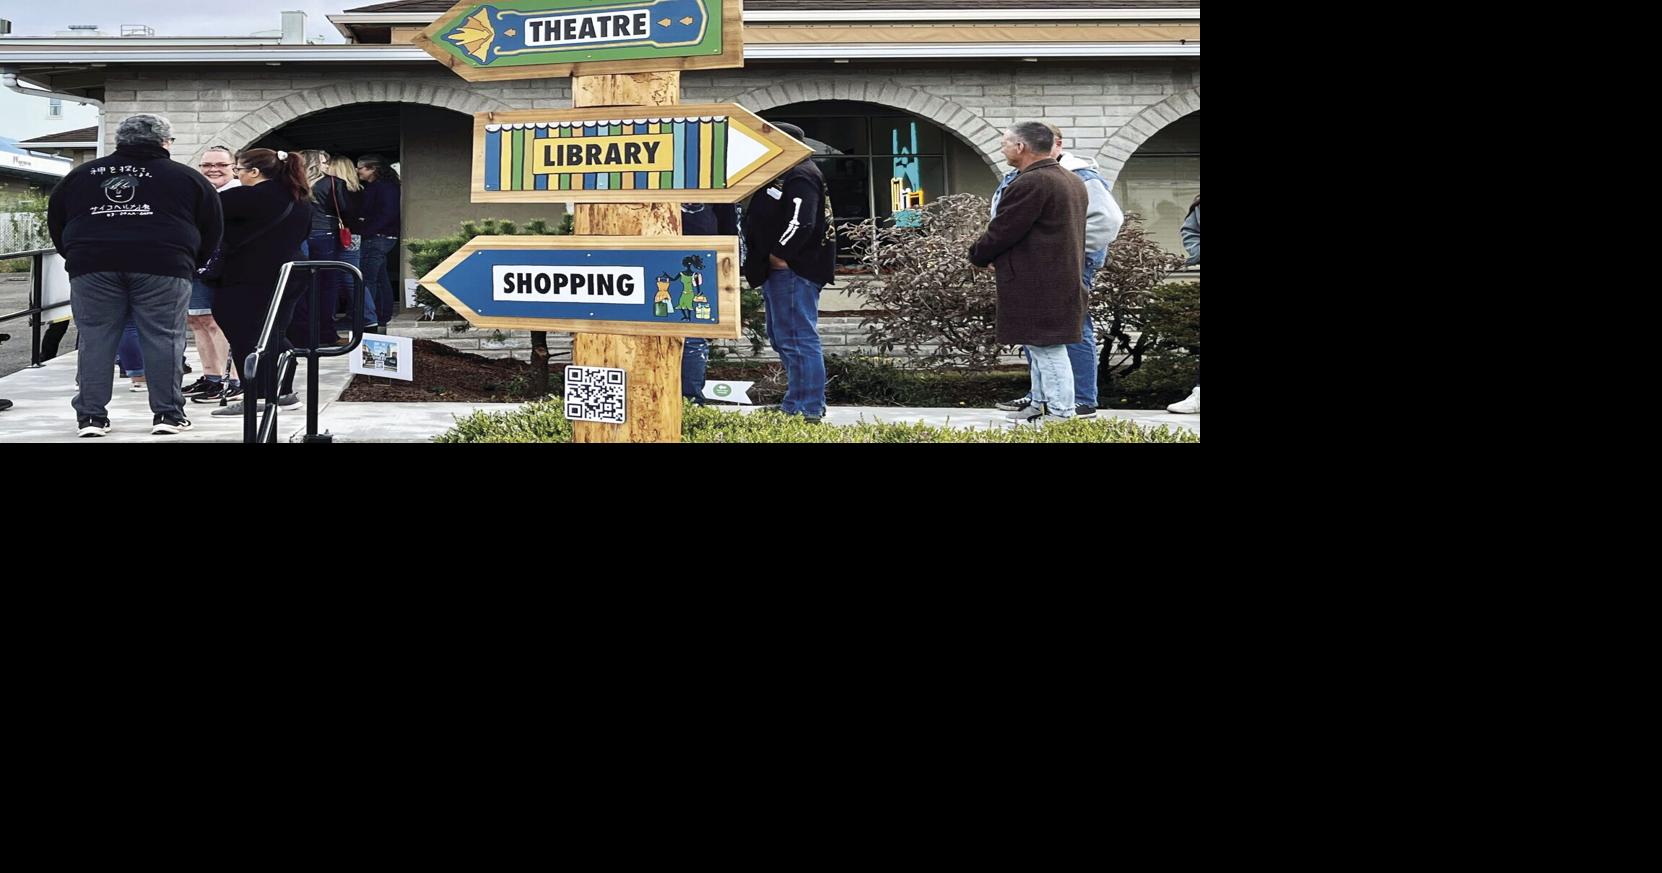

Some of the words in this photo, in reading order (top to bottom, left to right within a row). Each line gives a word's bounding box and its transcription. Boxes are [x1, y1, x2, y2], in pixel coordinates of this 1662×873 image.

[529, 13, 647, 42] THEATRE
[544, 141, 660, 167] LIBRARY
[503, 272, 635, 297] SHOPPING
